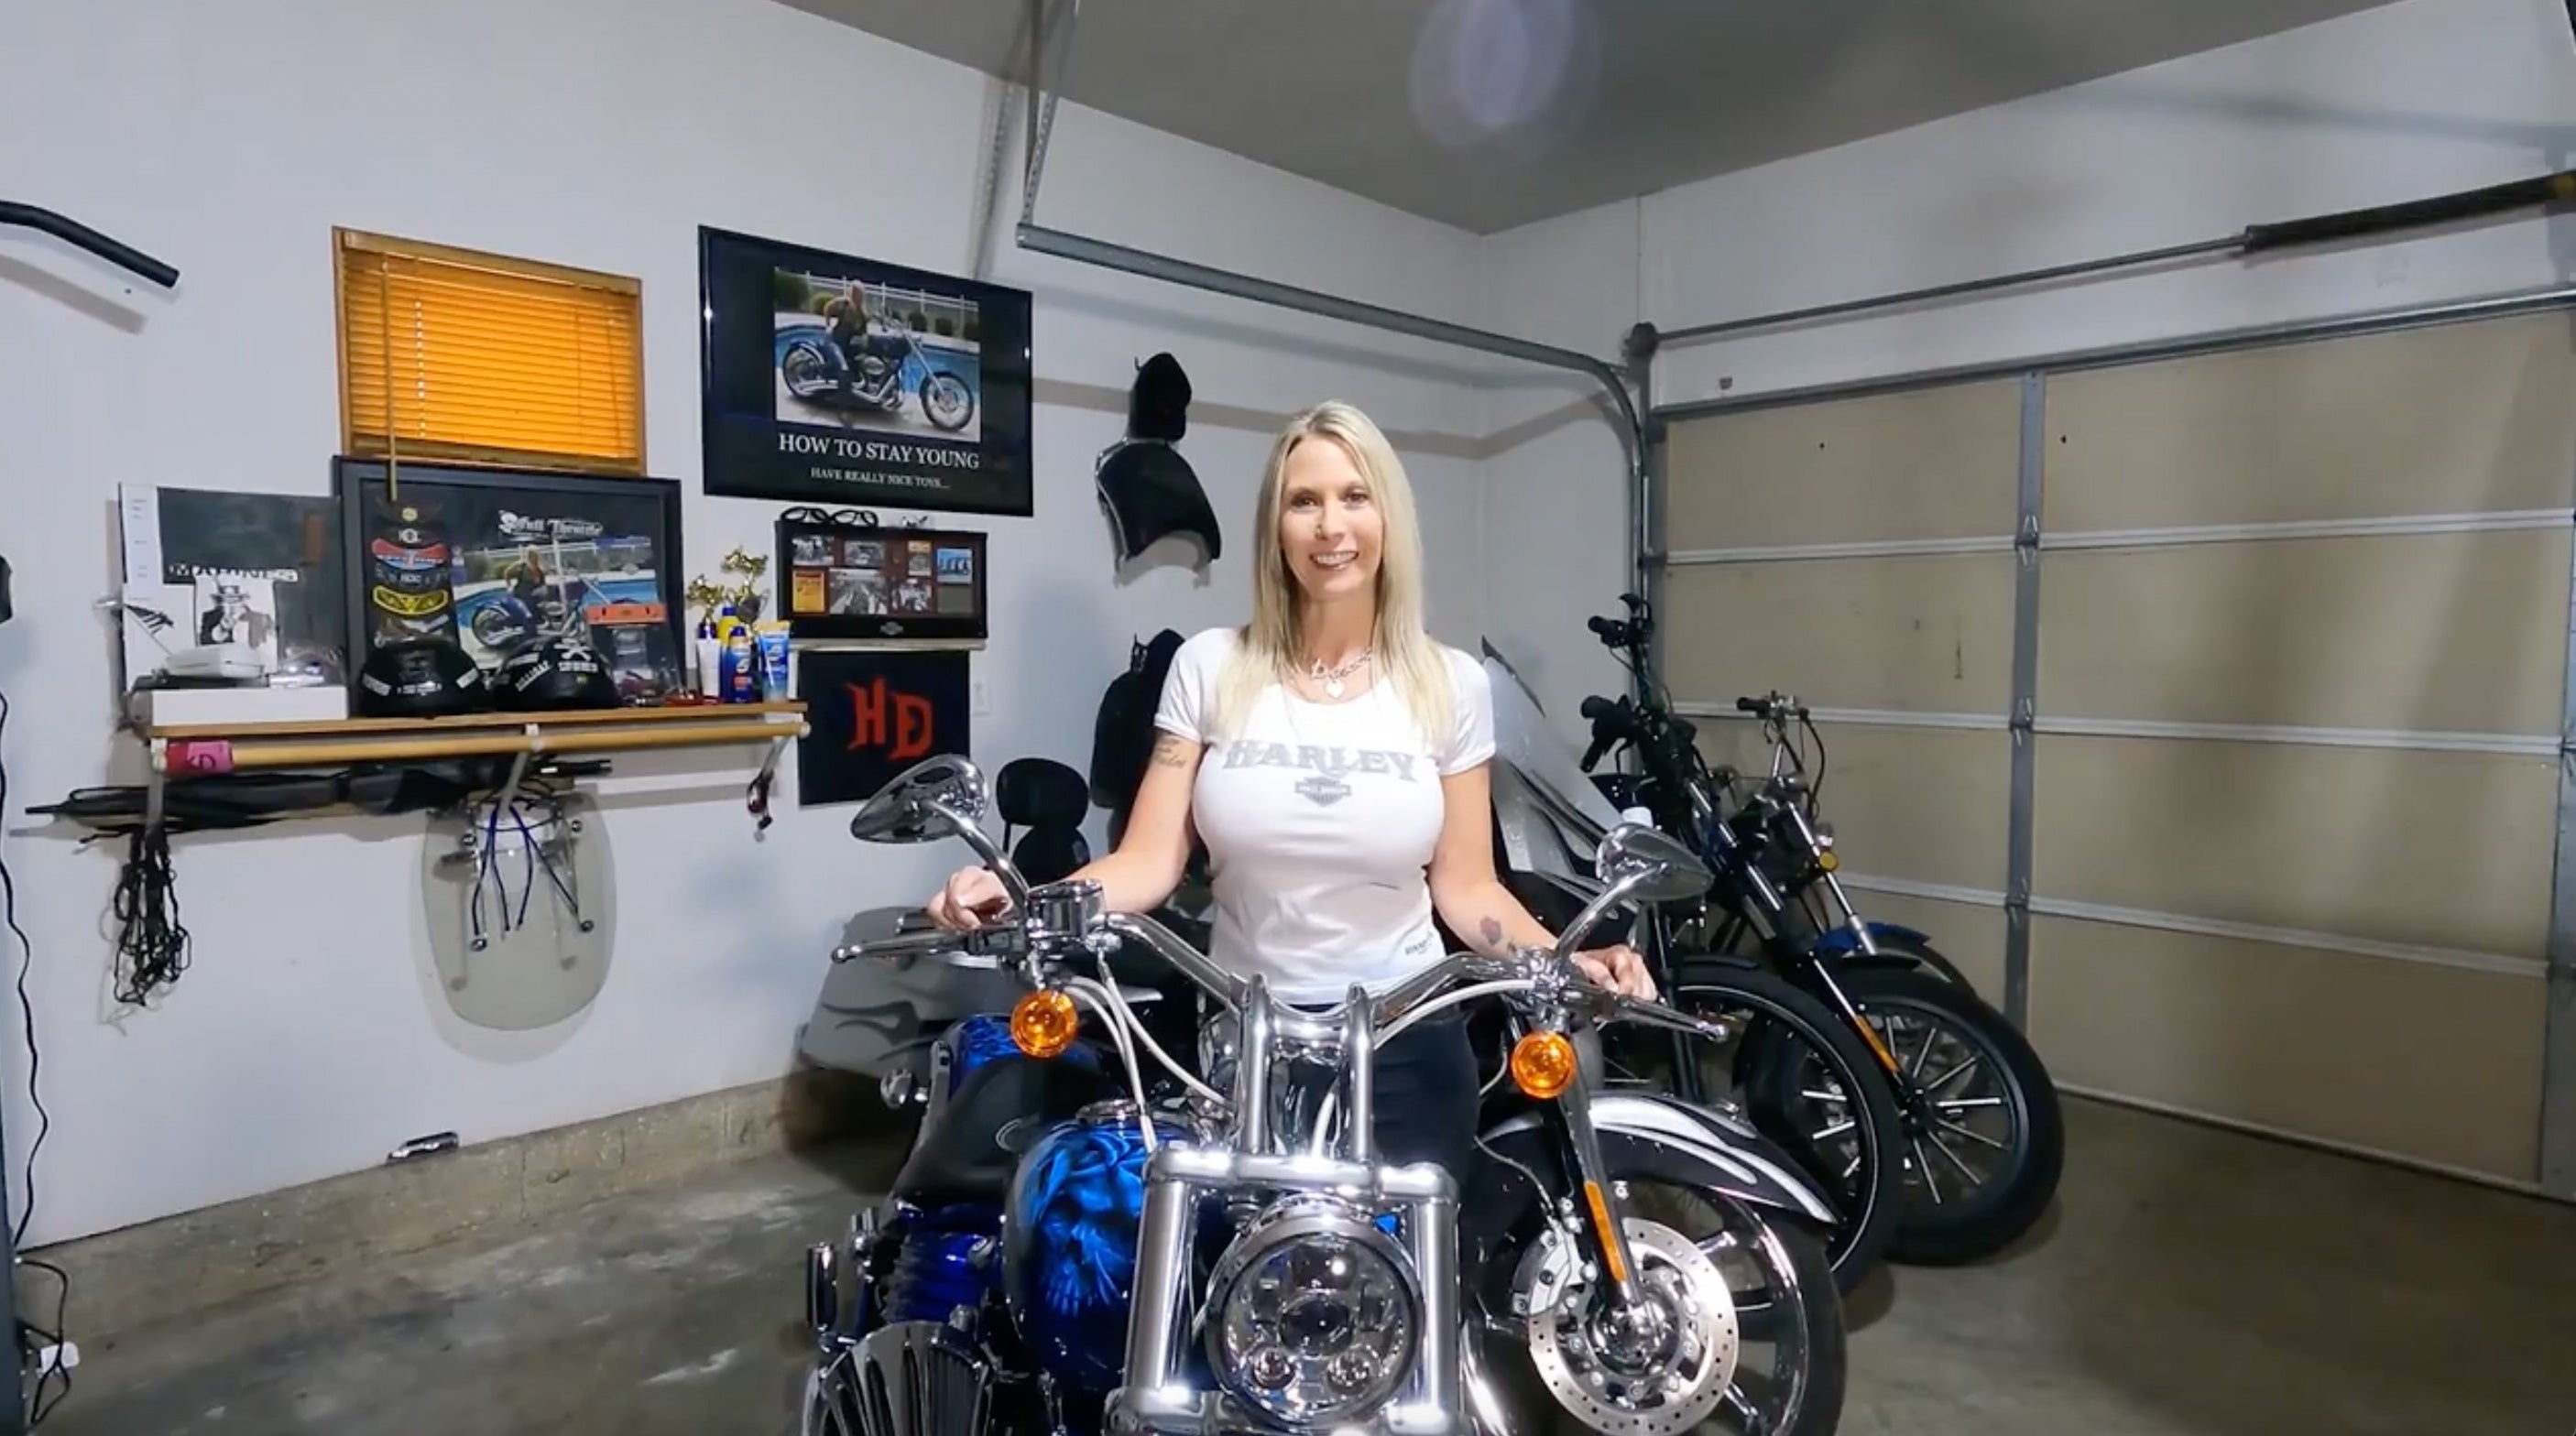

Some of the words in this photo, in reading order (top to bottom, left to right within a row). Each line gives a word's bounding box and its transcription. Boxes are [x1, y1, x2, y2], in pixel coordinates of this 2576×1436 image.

[779, 433, 829, 454] HOW
[835, 438, 862, 457] TO
[866, 442, 912, 463] STAY
[916, 446, 979, 469] YOUNG
[811, 467, 843, 481] HAVE
[845, 470, 885, 485] REALLY
[888, 474, 913, 486] NICE
[843, 676, 933, 759] HD
[1222, 739, 1418, 783] HARLEY
